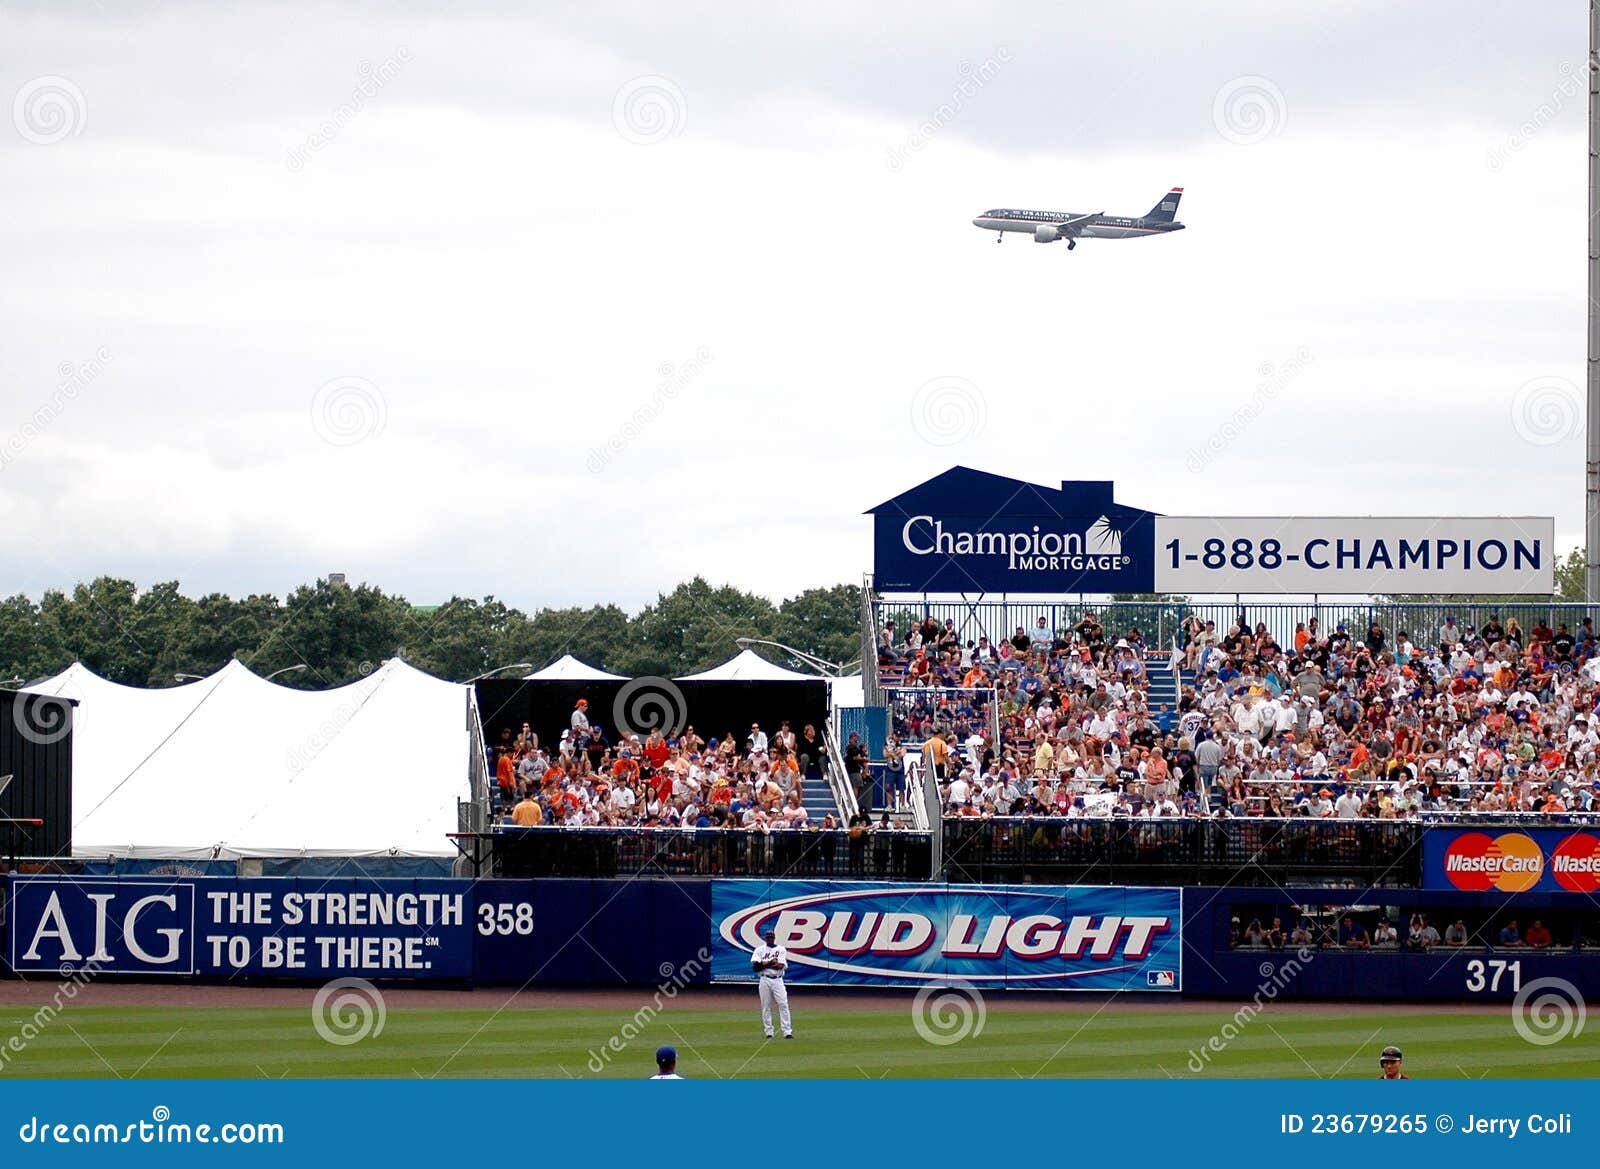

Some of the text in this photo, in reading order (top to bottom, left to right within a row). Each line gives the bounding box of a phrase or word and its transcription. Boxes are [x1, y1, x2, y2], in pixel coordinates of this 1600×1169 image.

[902, 515, 1083, 570] Champion
[1165, 538, 1541, 570] 1-888-CHAMPION
[1187, 721, 1200, 731] 37
[1446, 854, 1540, 873] MasterCard
[207, 891, 463, 926] THE STRENGTH
[477, 902, 534, 936] 358
[22, 889, 184, 965] AIG
[772, 910, 1172, 960] BUD LIGHT
[207, 936, 251, 968] TO
[262, 936, 305, 968] BE
[1466, 959, 1521, 993] 371
